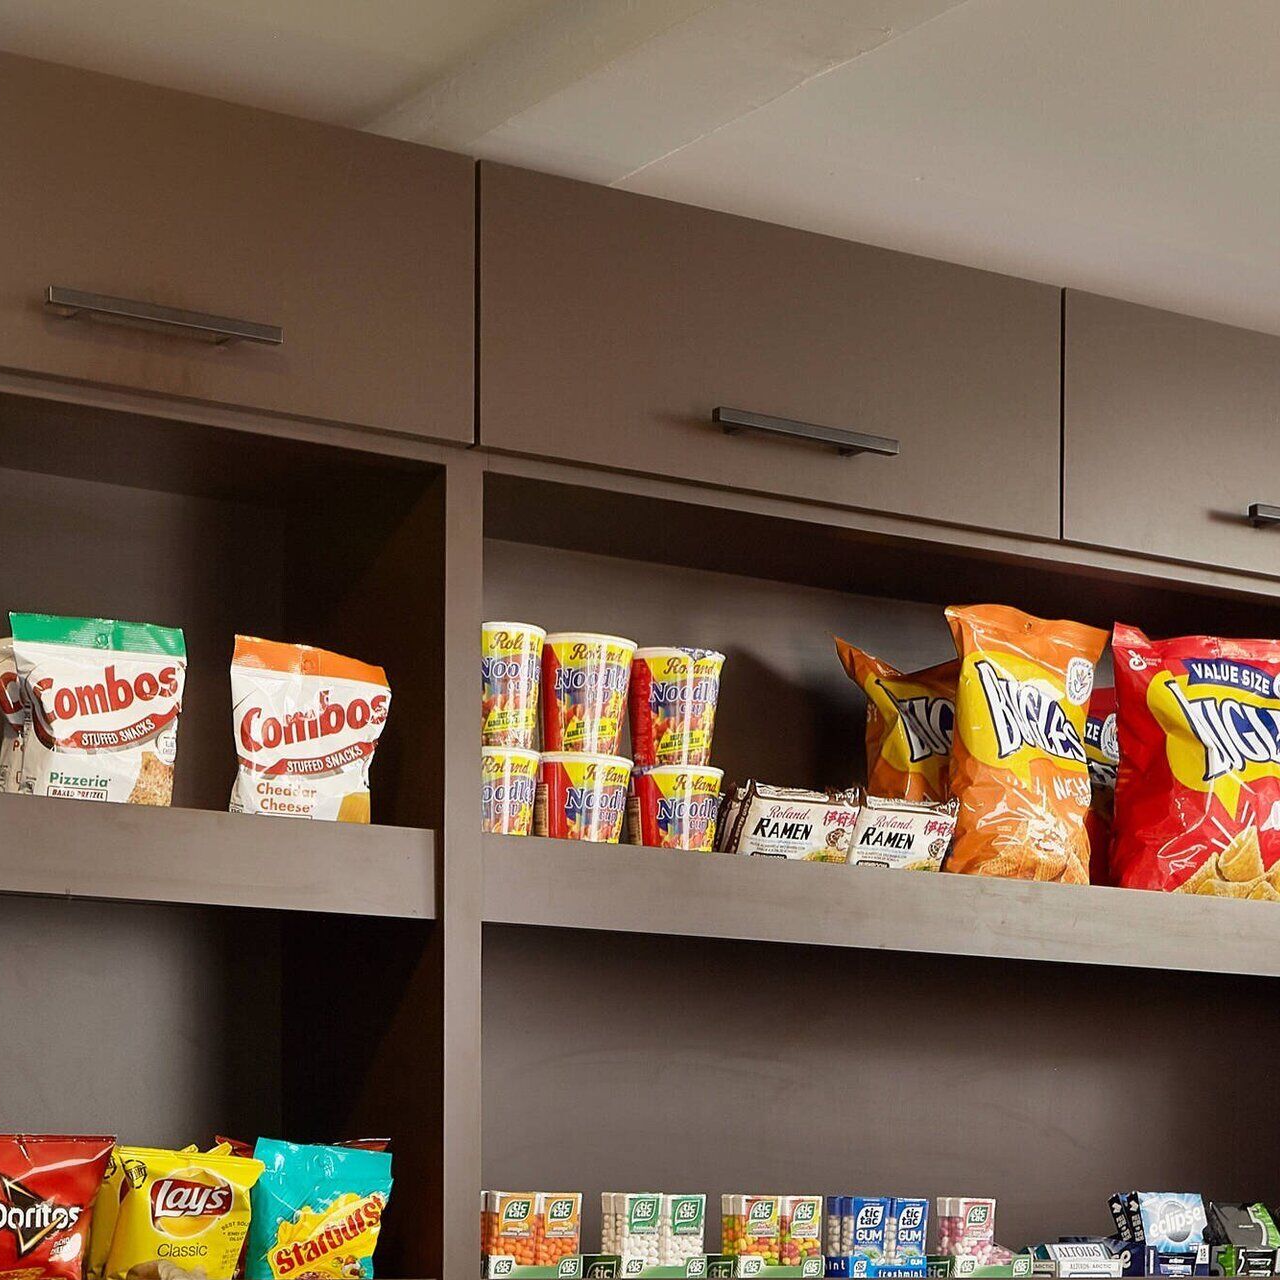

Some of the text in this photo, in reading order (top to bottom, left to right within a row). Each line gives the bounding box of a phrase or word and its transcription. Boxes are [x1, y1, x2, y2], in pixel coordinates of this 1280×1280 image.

[1192, 663, 1239, 684] VALUE
[1241, 668, 1271, 695] SIZE
[32, 665, 179, 722] Combos
[240, 690, 388, 752] Combos
[81, 718, 156, 747] STUFFED SNACKS
[286, 745, 364, 773] STUFFED SNACKS
[49, 771, 109, 788] Pizzeria
[260, 798, 311, 813] Cheese
[767, 805, 809, 820] Roland
[752, 818, 814, 840] RAMEN
[873, 815, 913, 830] Roland
[859, 827, 916, 850] RAMEN
[154, 1179, 230, 1218] Lay's
[512, 1200, 528, 1210] tic
[556, 1200, 571, 1210] tic
[640, 1201, 654, 1211] tic
[684, 1202, 697, 1212] tic
[864, 1207, 880, 1218] tic
[905, 1208, 920, 1218] tic
[508, 1208, 526, 1219] tac
[552, 1208, 569, 1219] tac
[634, 1208, 652, 1219] tac
[679, 1209, 696, 1219] tac
[970, 1214, 985, 1222] tac
[860, 1216, 879, 1226] tac
[901, 1216, 918, 1226] tac
[1148, 1206, 1201, 1238] eclipse
[273, 1192, 386, 1276] Starburst
[855, 1229, 883, 1242] GUM
[898, 1229, 921, 1242] GUM
[157, 1242, 208, 1258] Classic
[1056, 1245, 1102, 1259] ALTOIDS
[590, 1264, 613, 1279] tic
[711, 1265, 729, 1279] tic
[878, 1269, 923, 1279] freshmint
[927, 1266, 944, 1278] tic
